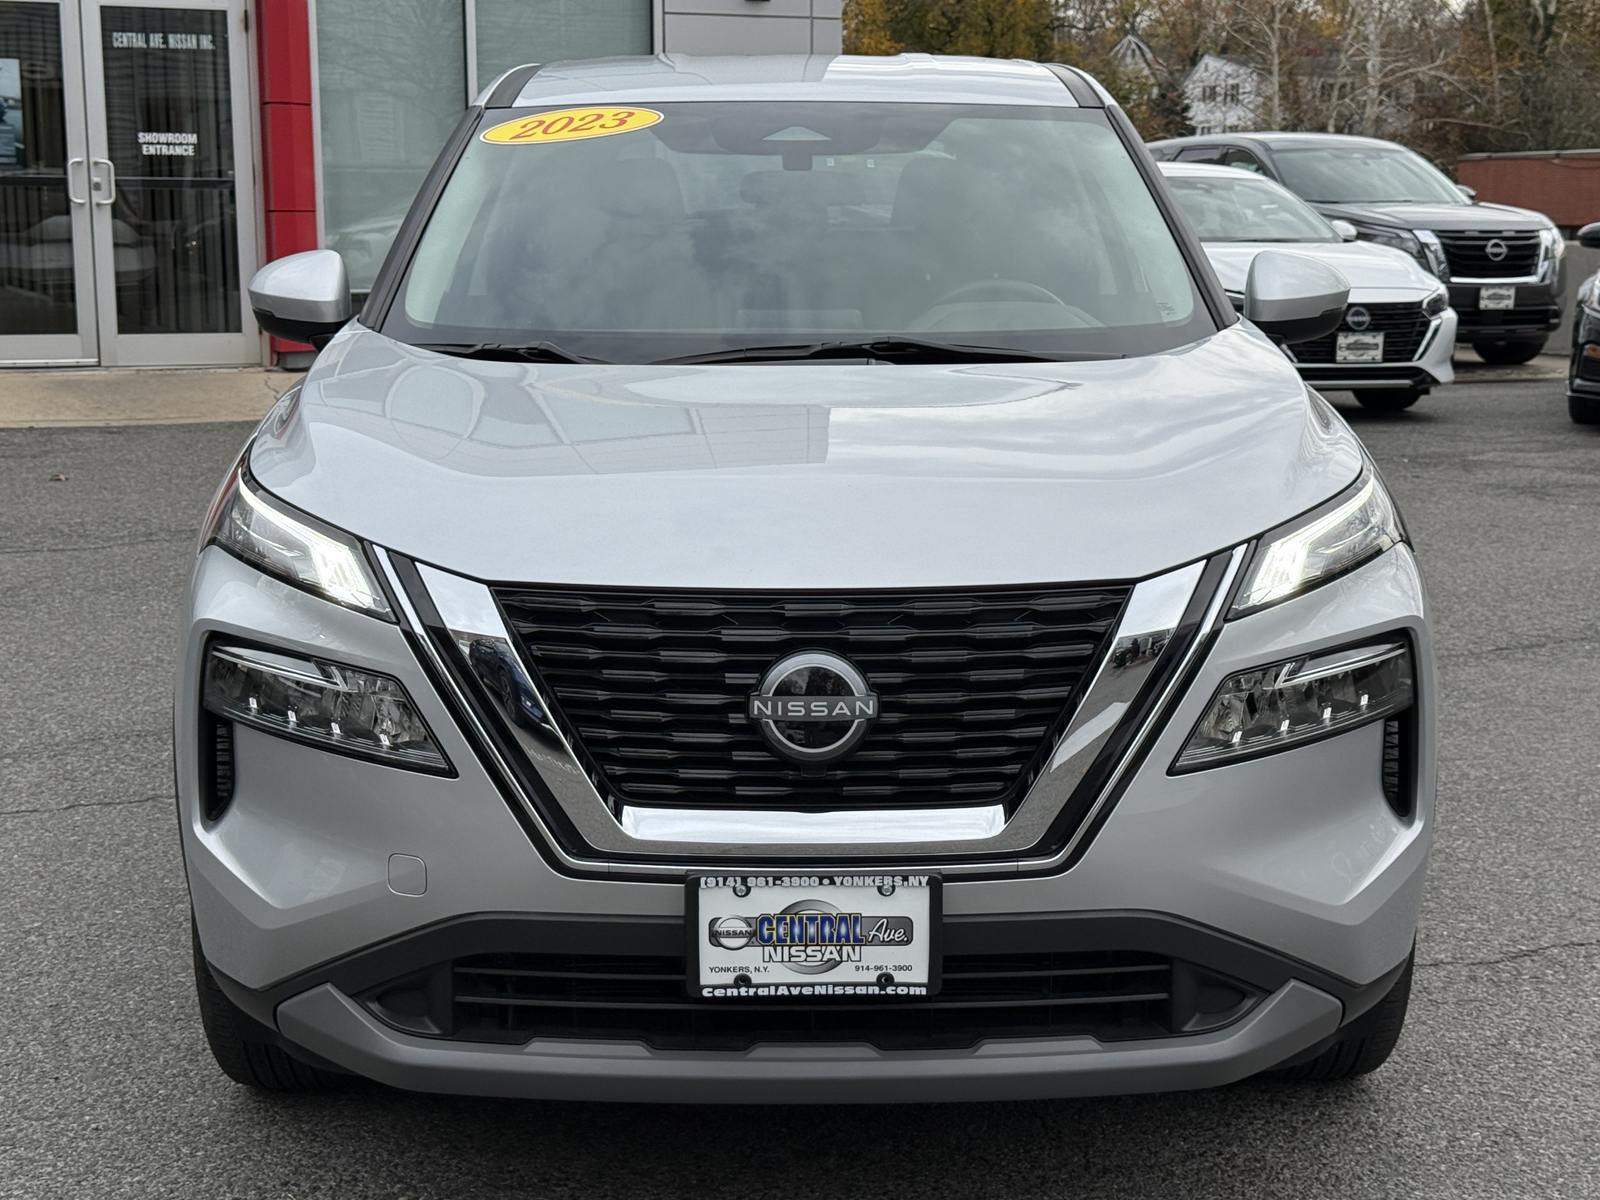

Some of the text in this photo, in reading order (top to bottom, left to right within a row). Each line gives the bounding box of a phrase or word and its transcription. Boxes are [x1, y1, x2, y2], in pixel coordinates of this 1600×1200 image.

[112, 31, 216, 50] CENTRAL AVE. NISSAN INC.
[509, 111, 635, 140] 2023
[137, 131, 198, 144] SHOWROOM
[142, 144, 195, 156] ENTRANCE
[753, 700, 874, 717] NISSAN
[746, 876, 820, 888] 961-3900
[756, 913, 909, 946] CENTRAL Ave.
[762, 945, 862, 963] NISSAN
[709, 965, 770, 974] YONKERS, N.Y.
[854, 964, 913, 972] 914-961-3900
